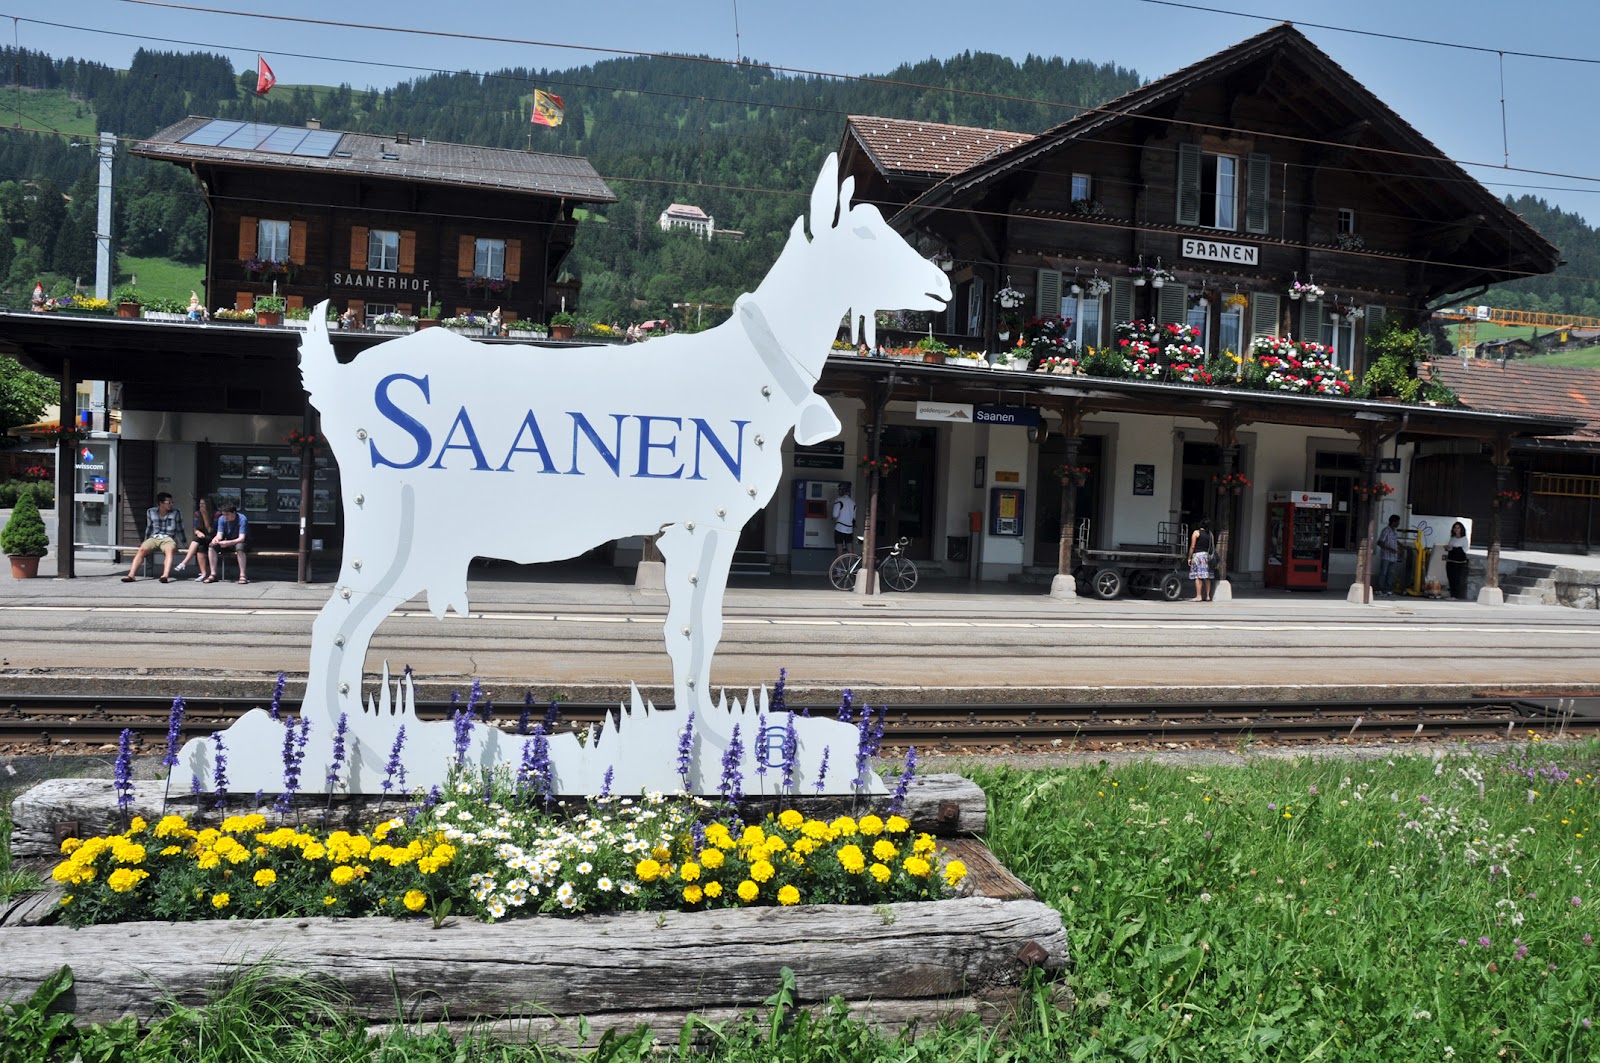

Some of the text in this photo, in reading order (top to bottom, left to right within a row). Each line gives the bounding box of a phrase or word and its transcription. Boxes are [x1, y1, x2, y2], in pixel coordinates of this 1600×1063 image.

[1185, 241, 1254, 262] SAANEN
[333, 272, 430, 291] SAANERHOF
[976, 410, 1015, 422] Saanen
[369, 373, 752, 483] SAANEN
